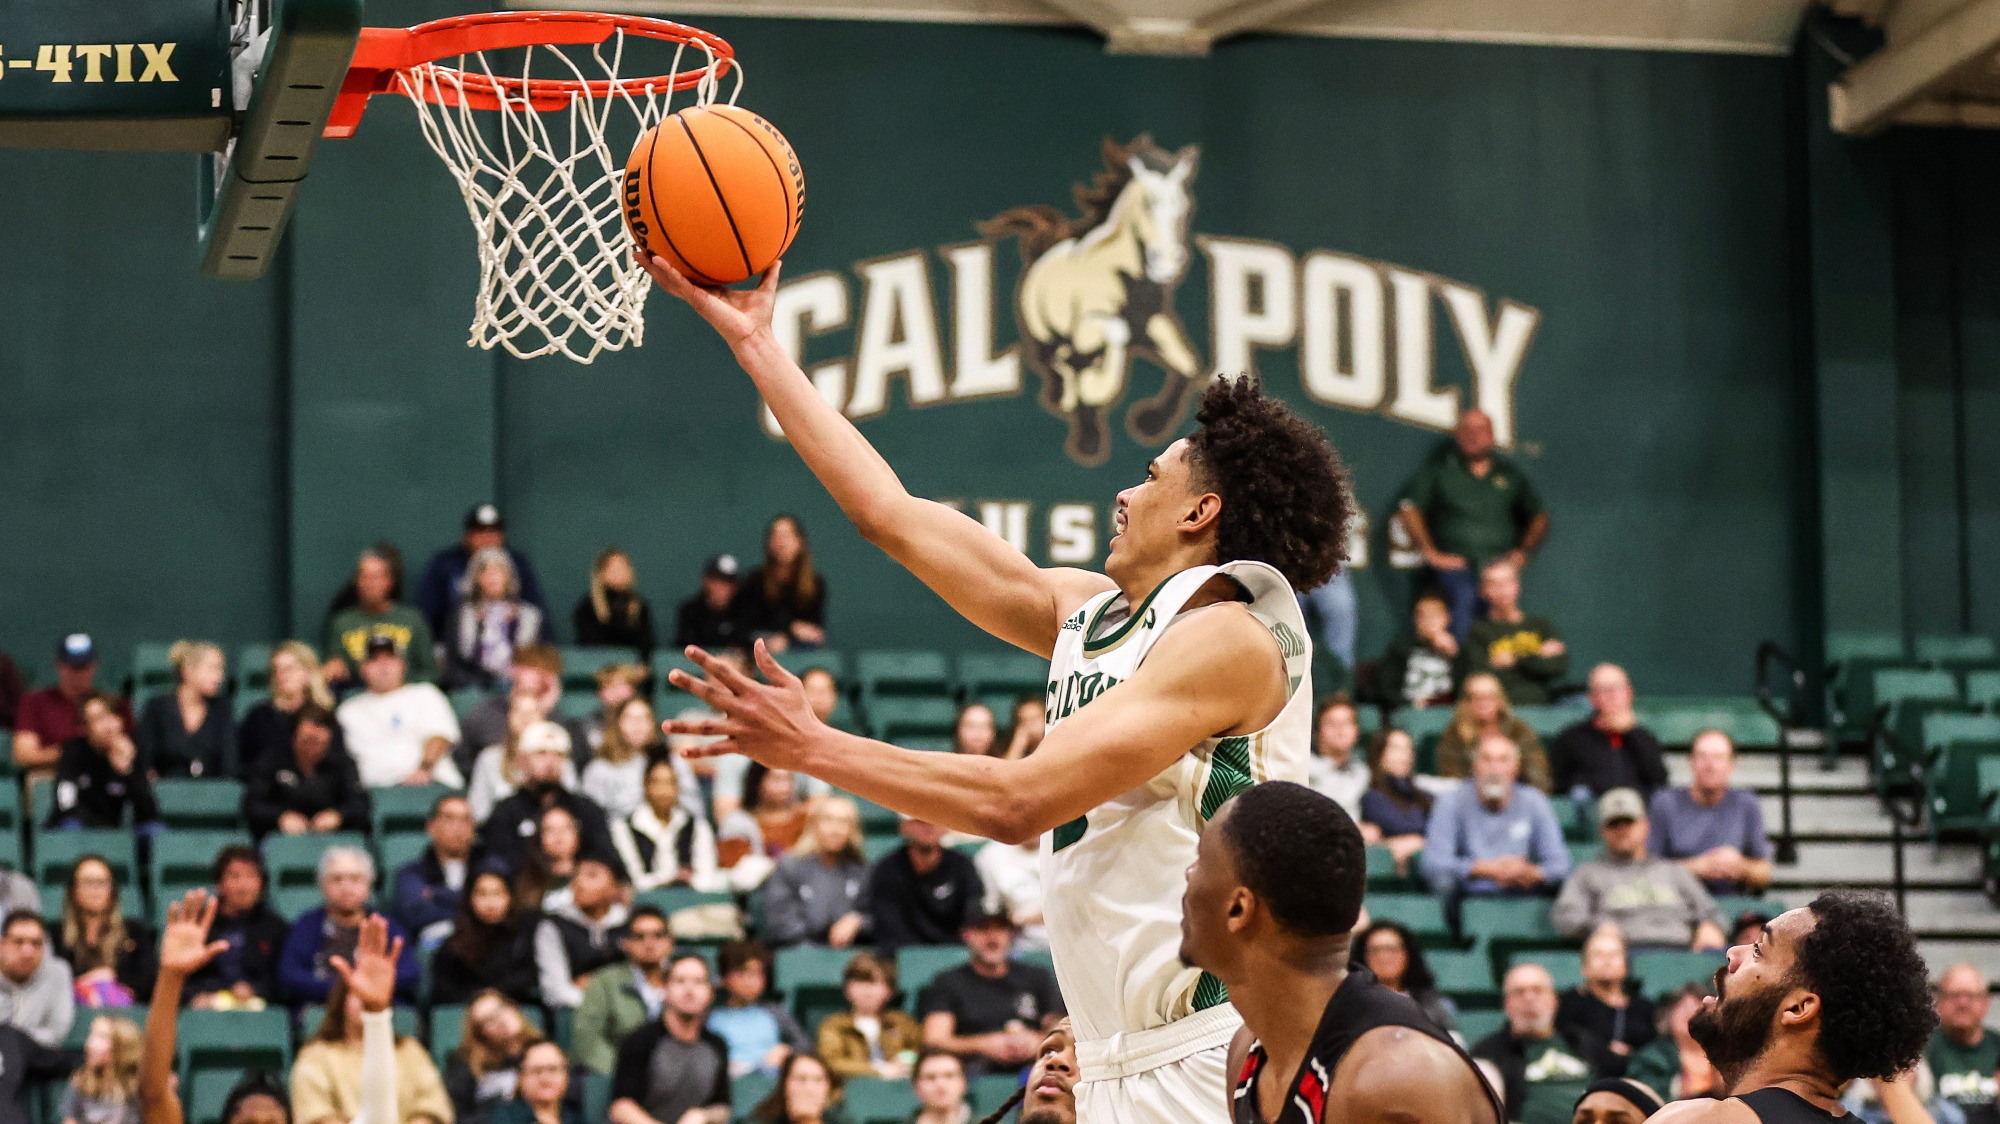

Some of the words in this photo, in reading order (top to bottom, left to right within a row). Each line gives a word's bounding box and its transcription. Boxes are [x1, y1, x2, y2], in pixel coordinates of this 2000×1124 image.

[0, 42, 180, 83] -4TIX
[759, 240, 1022, 439] CAL
[1195, 232, 1541, 450] POLY
